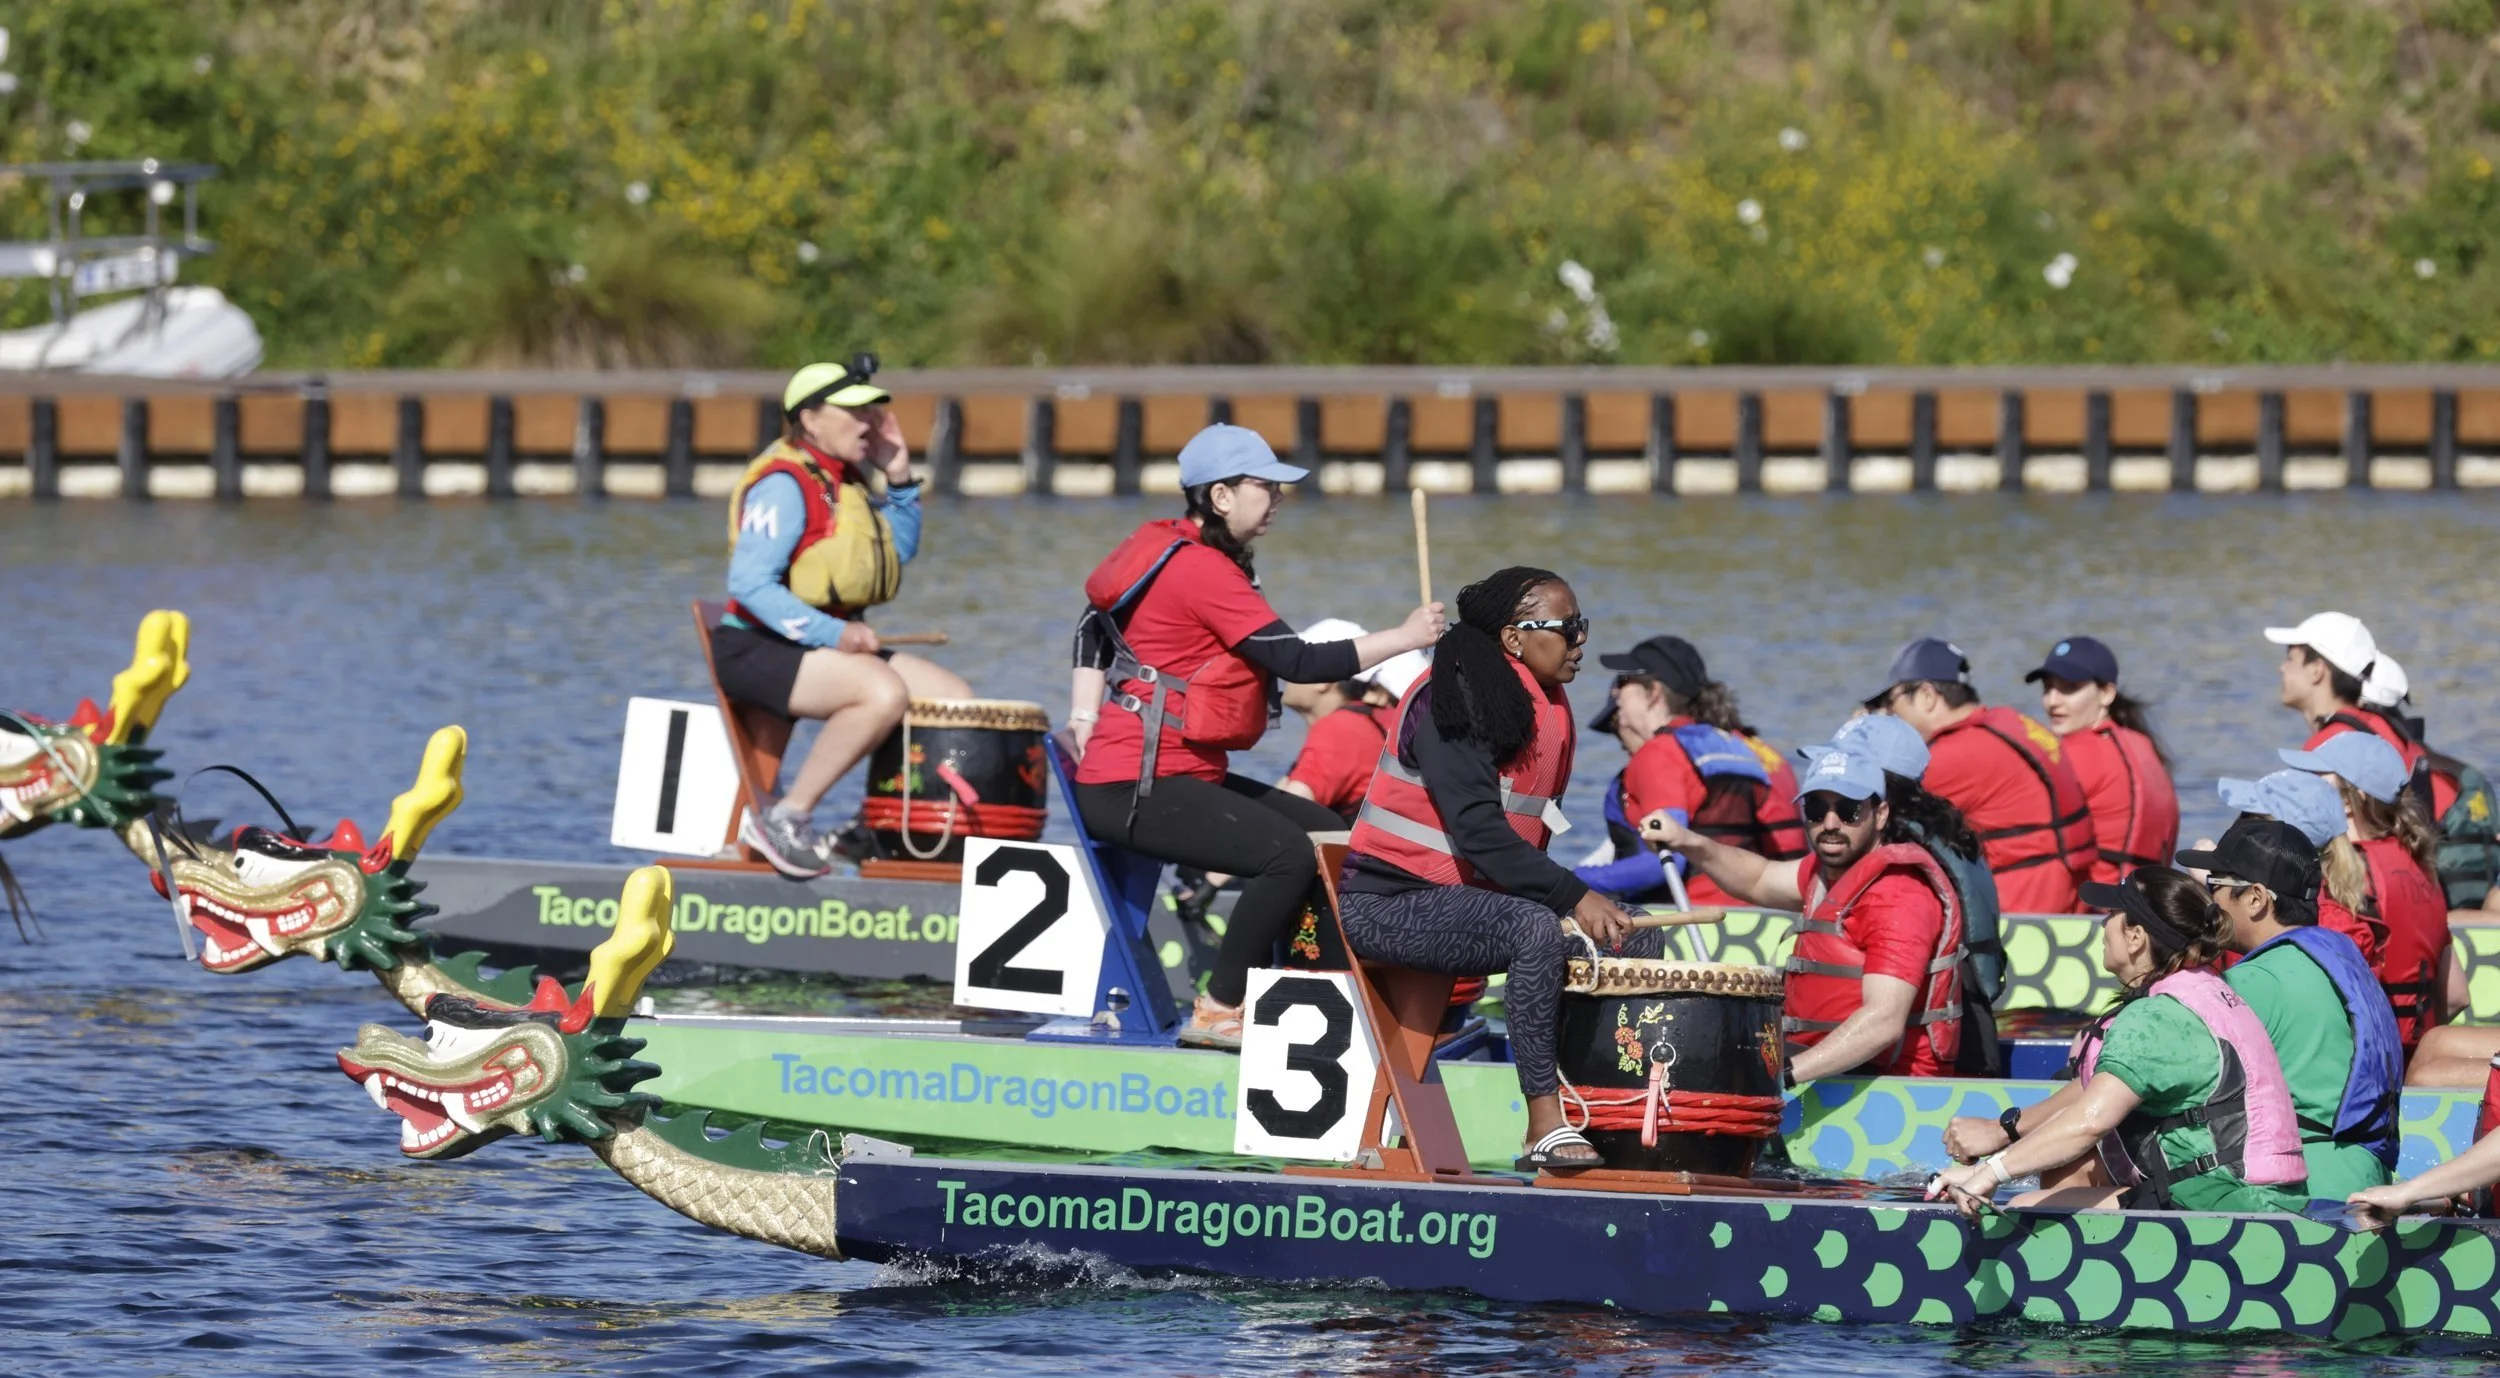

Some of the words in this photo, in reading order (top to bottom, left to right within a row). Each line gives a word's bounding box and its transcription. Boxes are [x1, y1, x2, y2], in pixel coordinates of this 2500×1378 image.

[656, 709, 688, 833] 1
[969, 847, 1070, 994] 2
[1246, 976, 1353, 1139] 3
[937, 1180, 1497, 1259] TacomaDragonBoat.org
